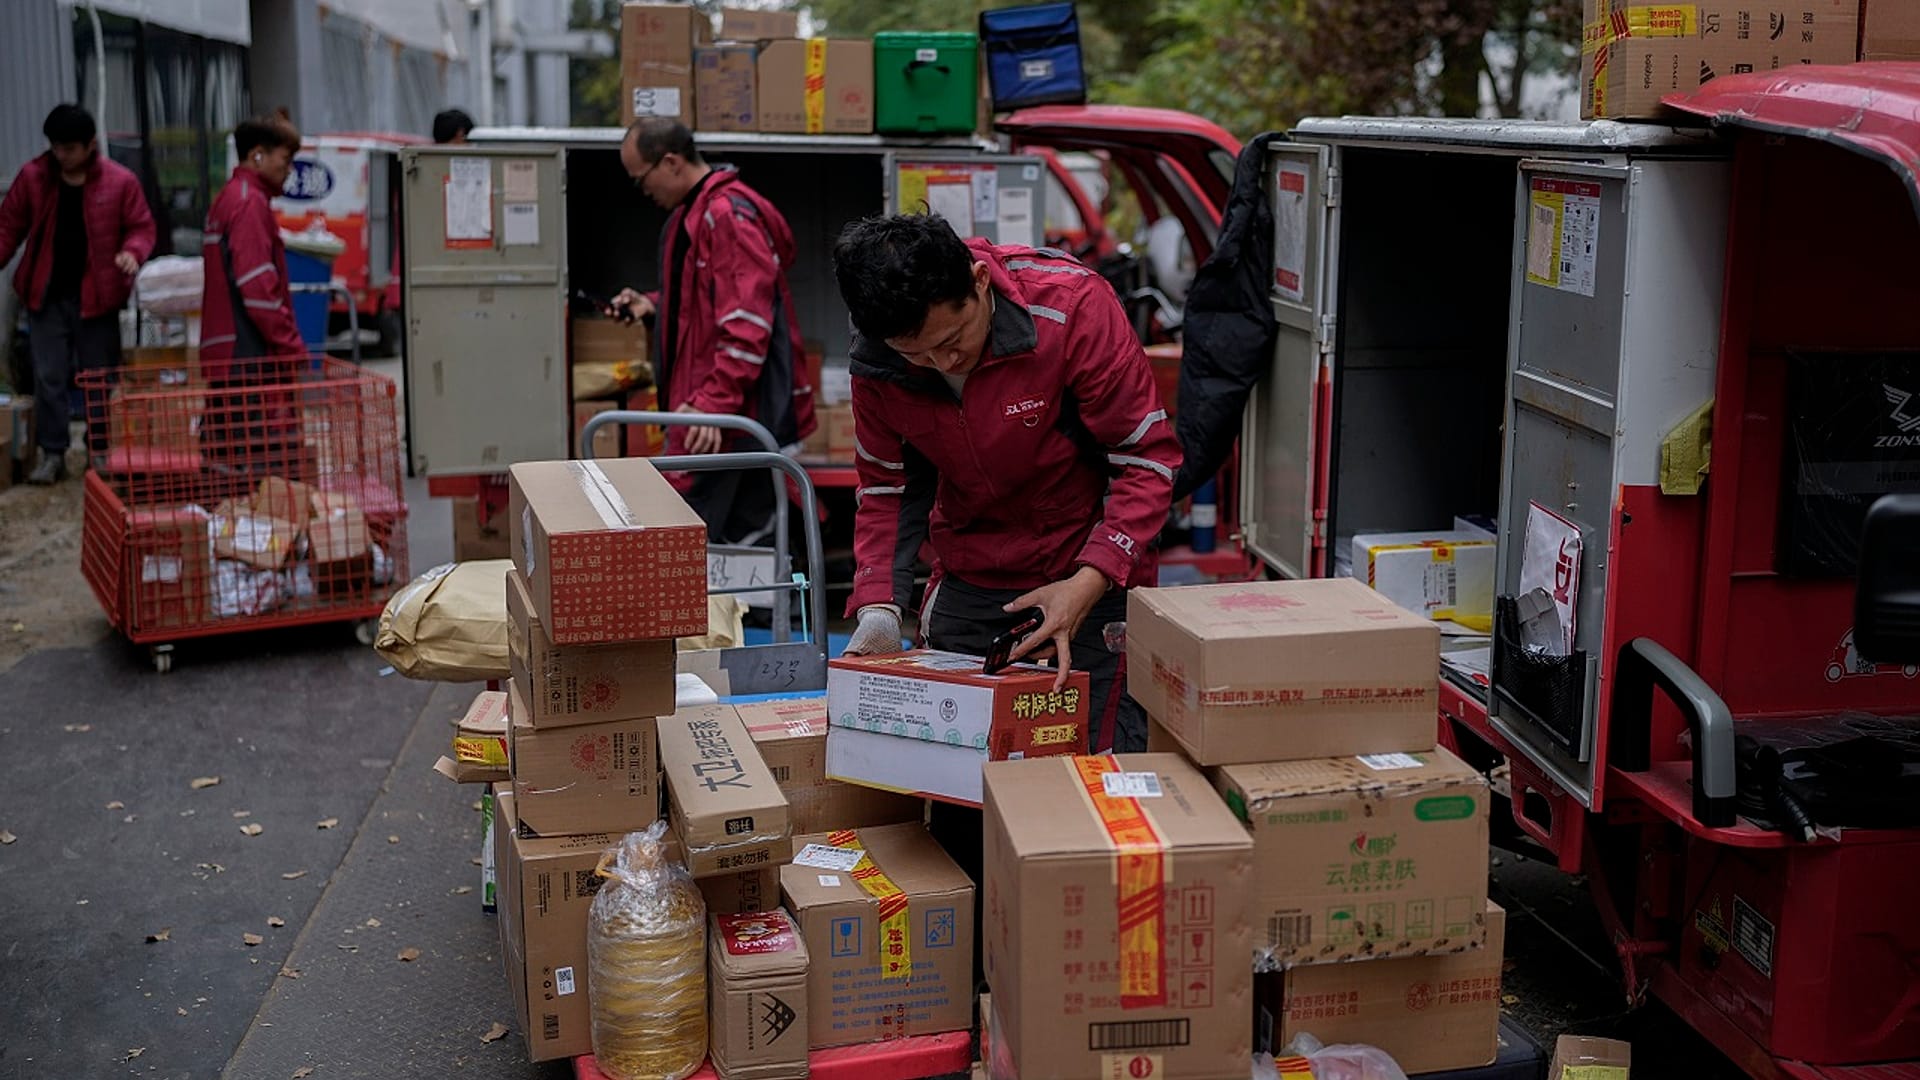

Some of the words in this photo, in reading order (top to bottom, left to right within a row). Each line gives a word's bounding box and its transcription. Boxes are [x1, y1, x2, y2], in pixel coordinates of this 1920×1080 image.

[1705, 13, 1720, 35] UR
[1107, 531, 1136, 556] JDL
[1322, 687, 1374, 699] 京东超市
[717, 849, 770, 868] 套装勿拆
[1324, 858, 1417, 885] 云感柔肤
